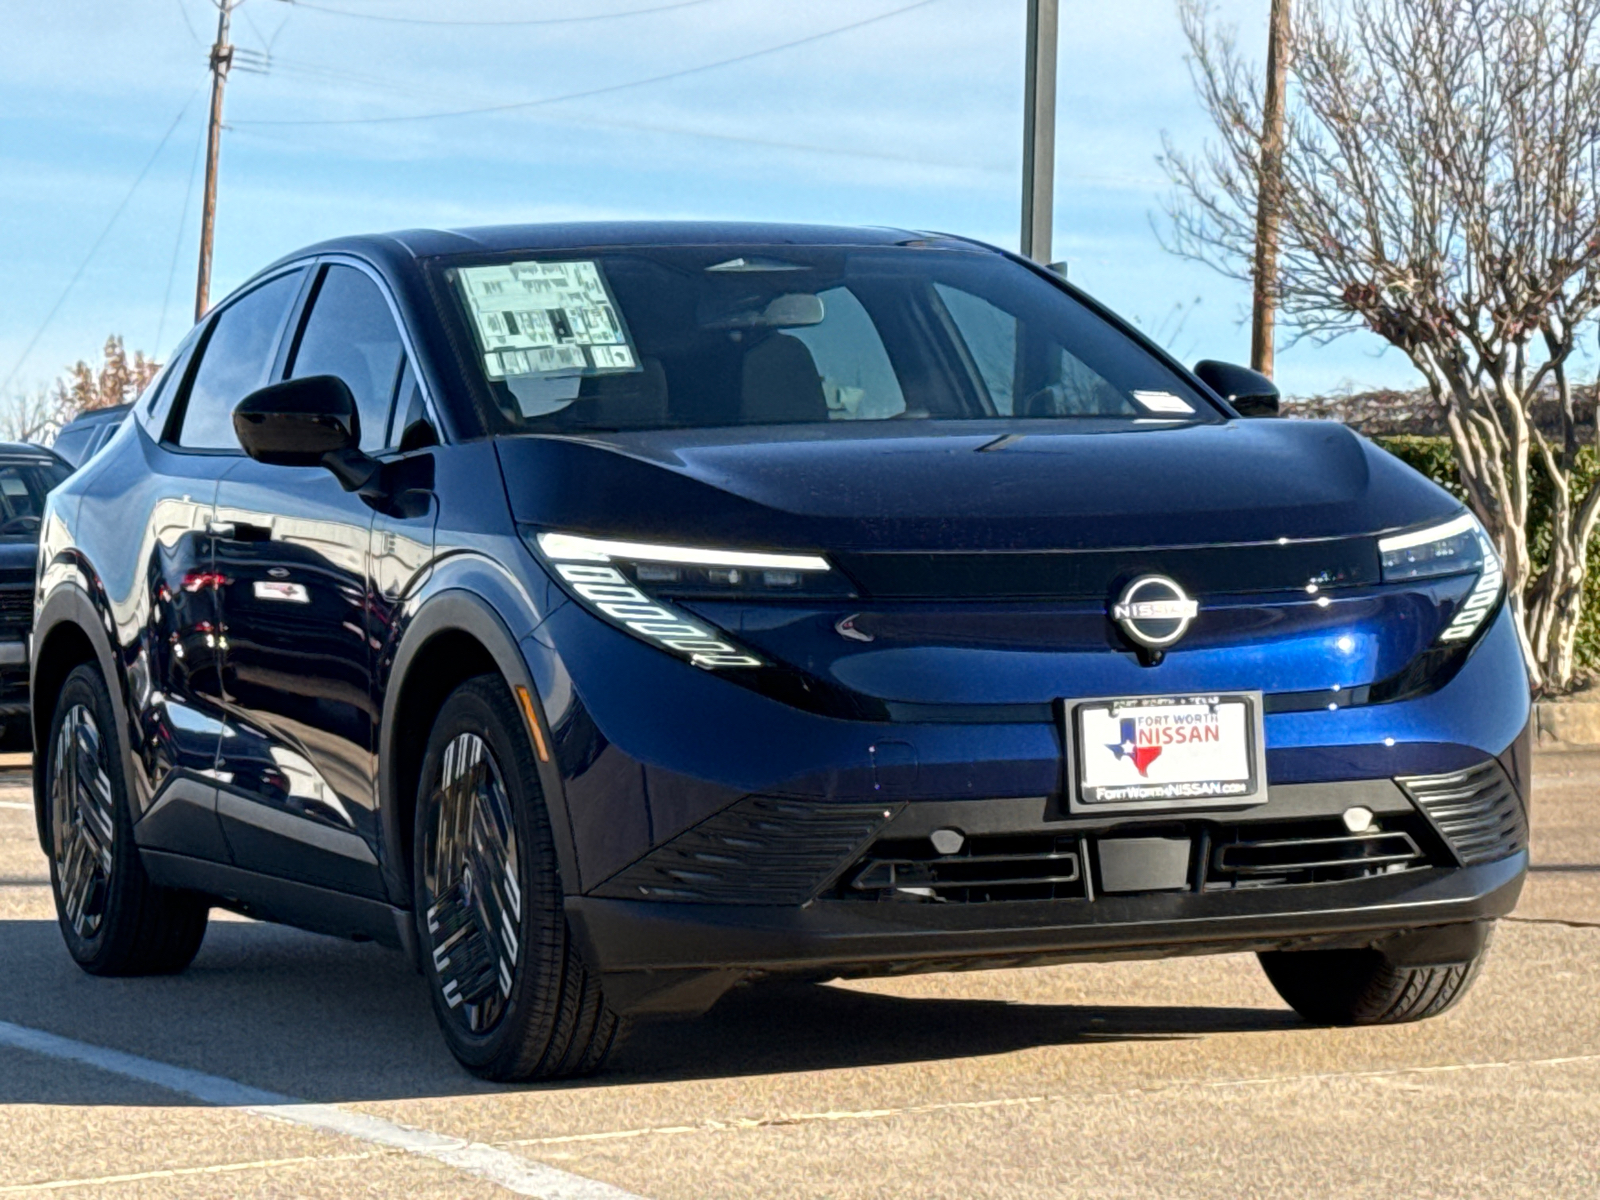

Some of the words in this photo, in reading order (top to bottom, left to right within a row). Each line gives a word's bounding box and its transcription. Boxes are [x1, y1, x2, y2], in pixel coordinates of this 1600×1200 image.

[1138, 715, 1169, 726] FORT
[1173, 713, 1218, 725] WORTH
[1139, 724, 1219, 744] NISSAN
